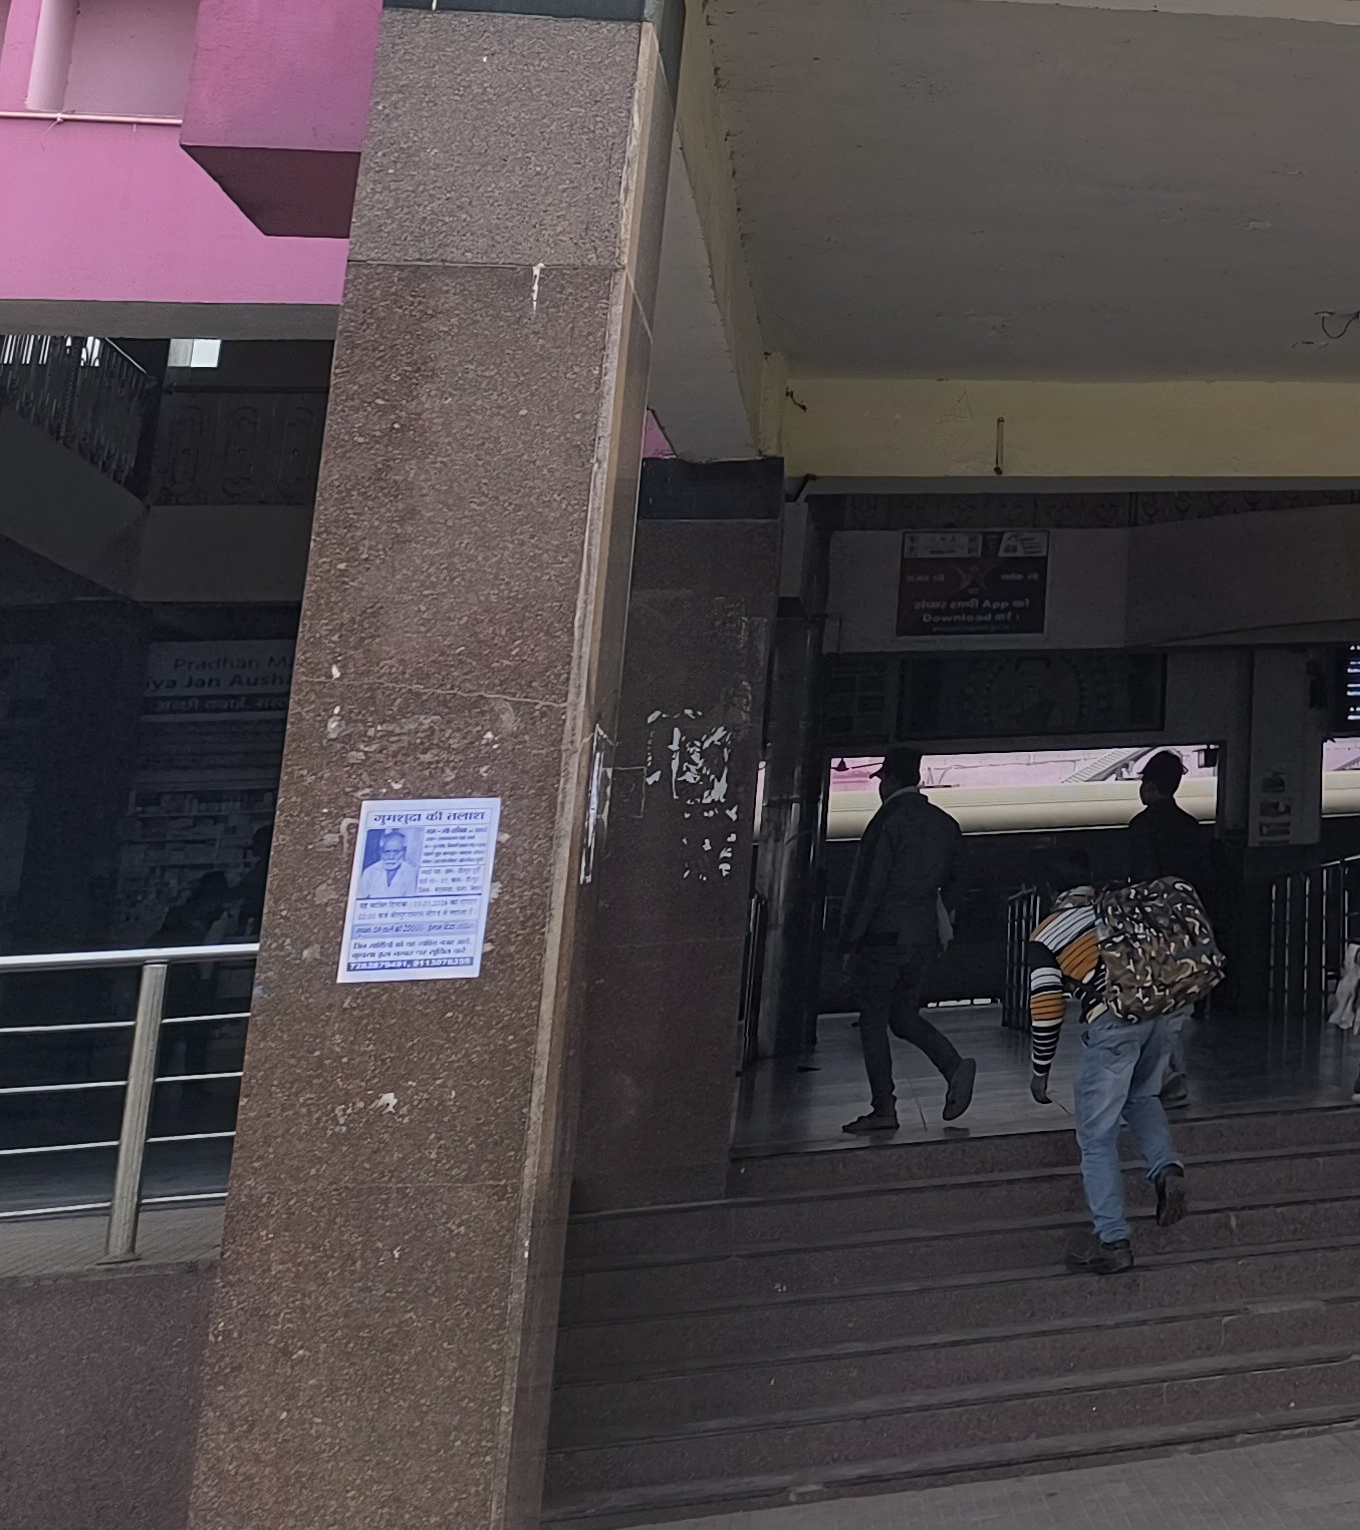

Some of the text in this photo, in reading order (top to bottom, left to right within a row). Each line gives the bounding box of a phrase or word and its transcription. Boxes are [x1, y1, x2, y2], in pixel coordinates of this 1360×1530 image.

[982, 599, 1010, 610] App
[922, 612, 992, 623] Download
[174, 656, 259, 671] Pradhan
[185, 675, 221, 689] Jan
[374, 811, 486, 825] गुमशुदा की तलाश
